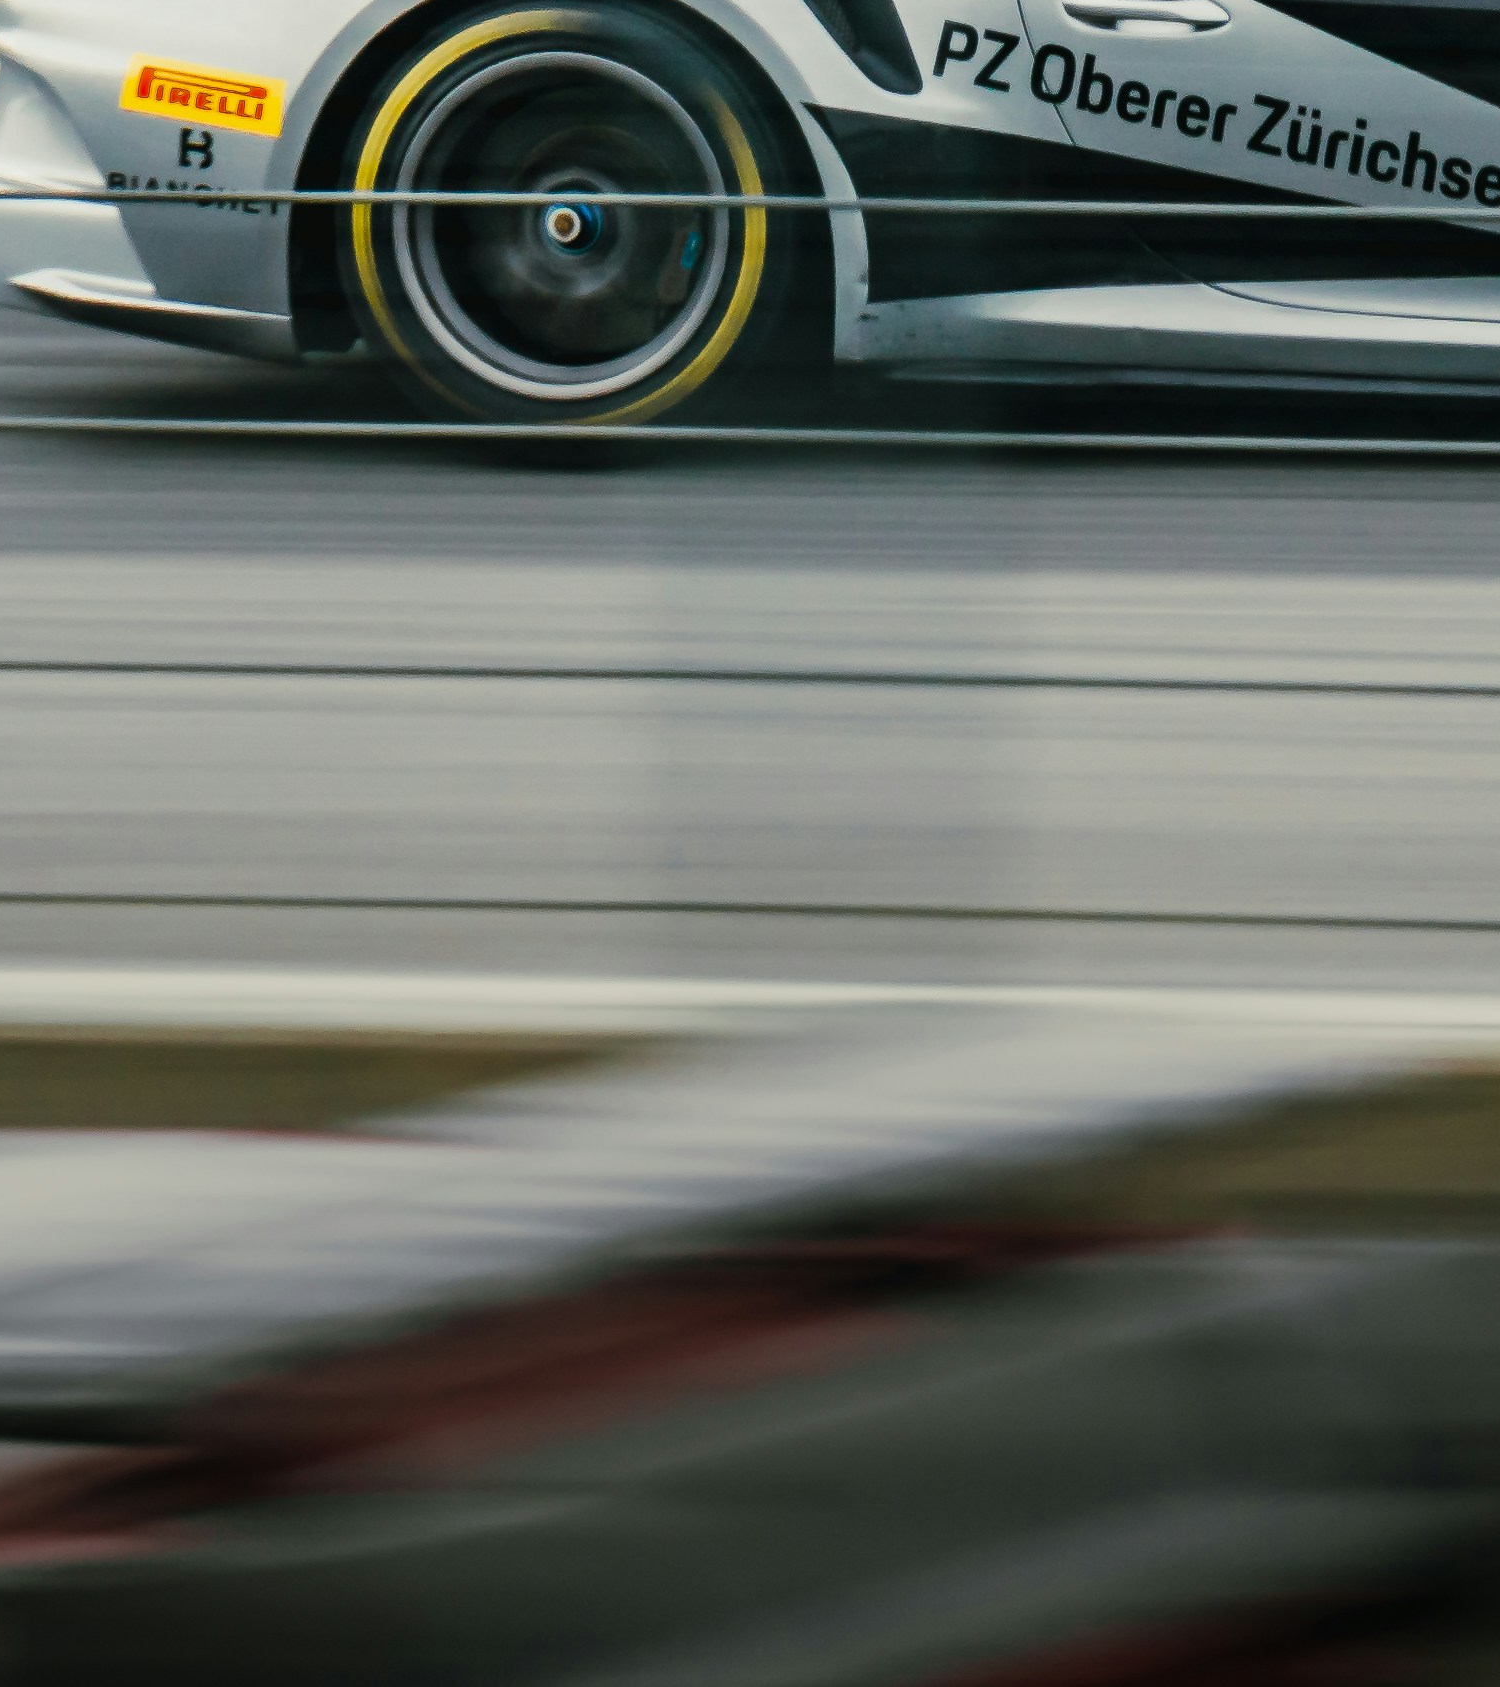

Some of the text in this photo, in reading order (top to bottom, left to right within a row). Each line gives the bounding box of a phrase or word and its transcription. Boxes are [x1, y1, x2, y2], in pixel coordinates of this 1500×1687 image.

[136, 65, 268, 120] PIRELLI
[932, 18, 1020, 93] PZ
[1030, 43, 1238, 143] Oberer
